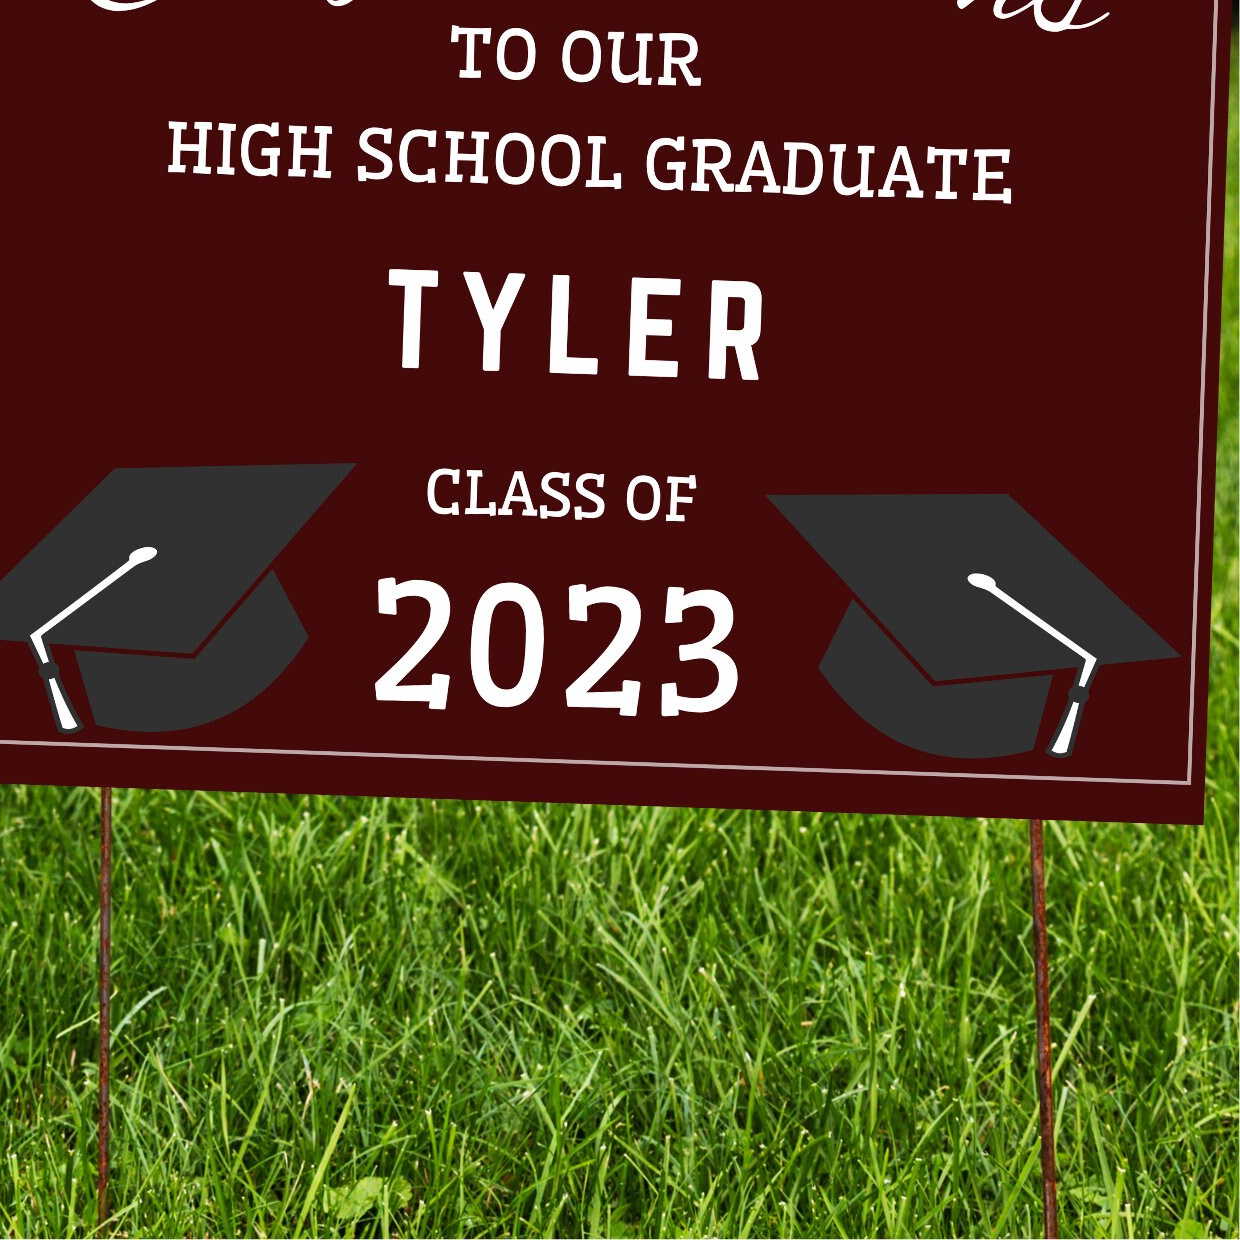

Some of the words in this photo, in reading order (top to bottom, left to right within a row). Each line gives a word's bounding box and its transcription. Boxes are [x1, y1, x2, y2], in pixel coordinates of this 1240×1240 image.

[450, 24, 537, 81] TO
[561, 29, 702, 87] OUR
[167, 120, 333, 179] HIGH
[357, 126, 622, 190] SCHOOL
[646, 135, 1012, 205] GRADUATE
[388, 268, 763, 381] TYLER
[426, 467, 606, 521] CLASS
[626, 474, 697, 522] OF
[374, 576, 739, 717] 2023
